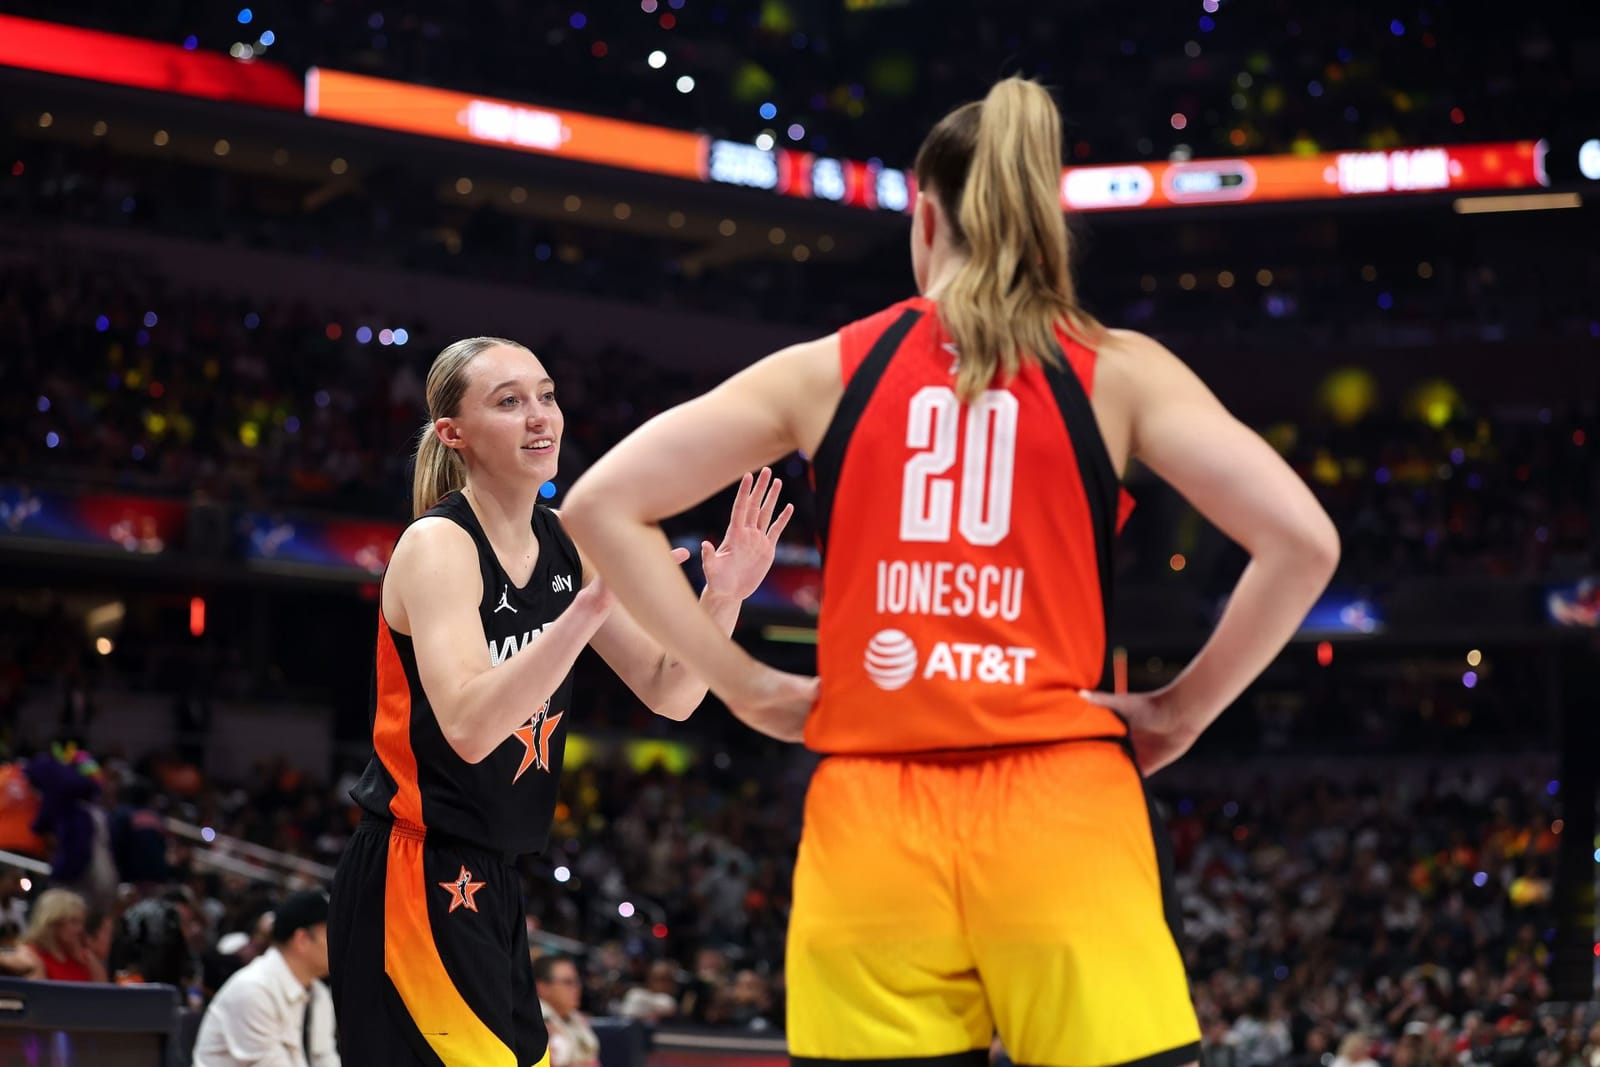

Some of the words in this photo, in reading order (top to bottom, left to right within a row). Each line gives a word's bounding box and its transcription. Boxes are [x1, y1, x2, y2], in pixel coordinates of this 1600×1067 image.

[899, 383, 1019, 546] 20
[551, 574, 573, 593] ally
[876, 559, 1025, 622] IONESCU
[922, 641, 1036, 685] AT&T
